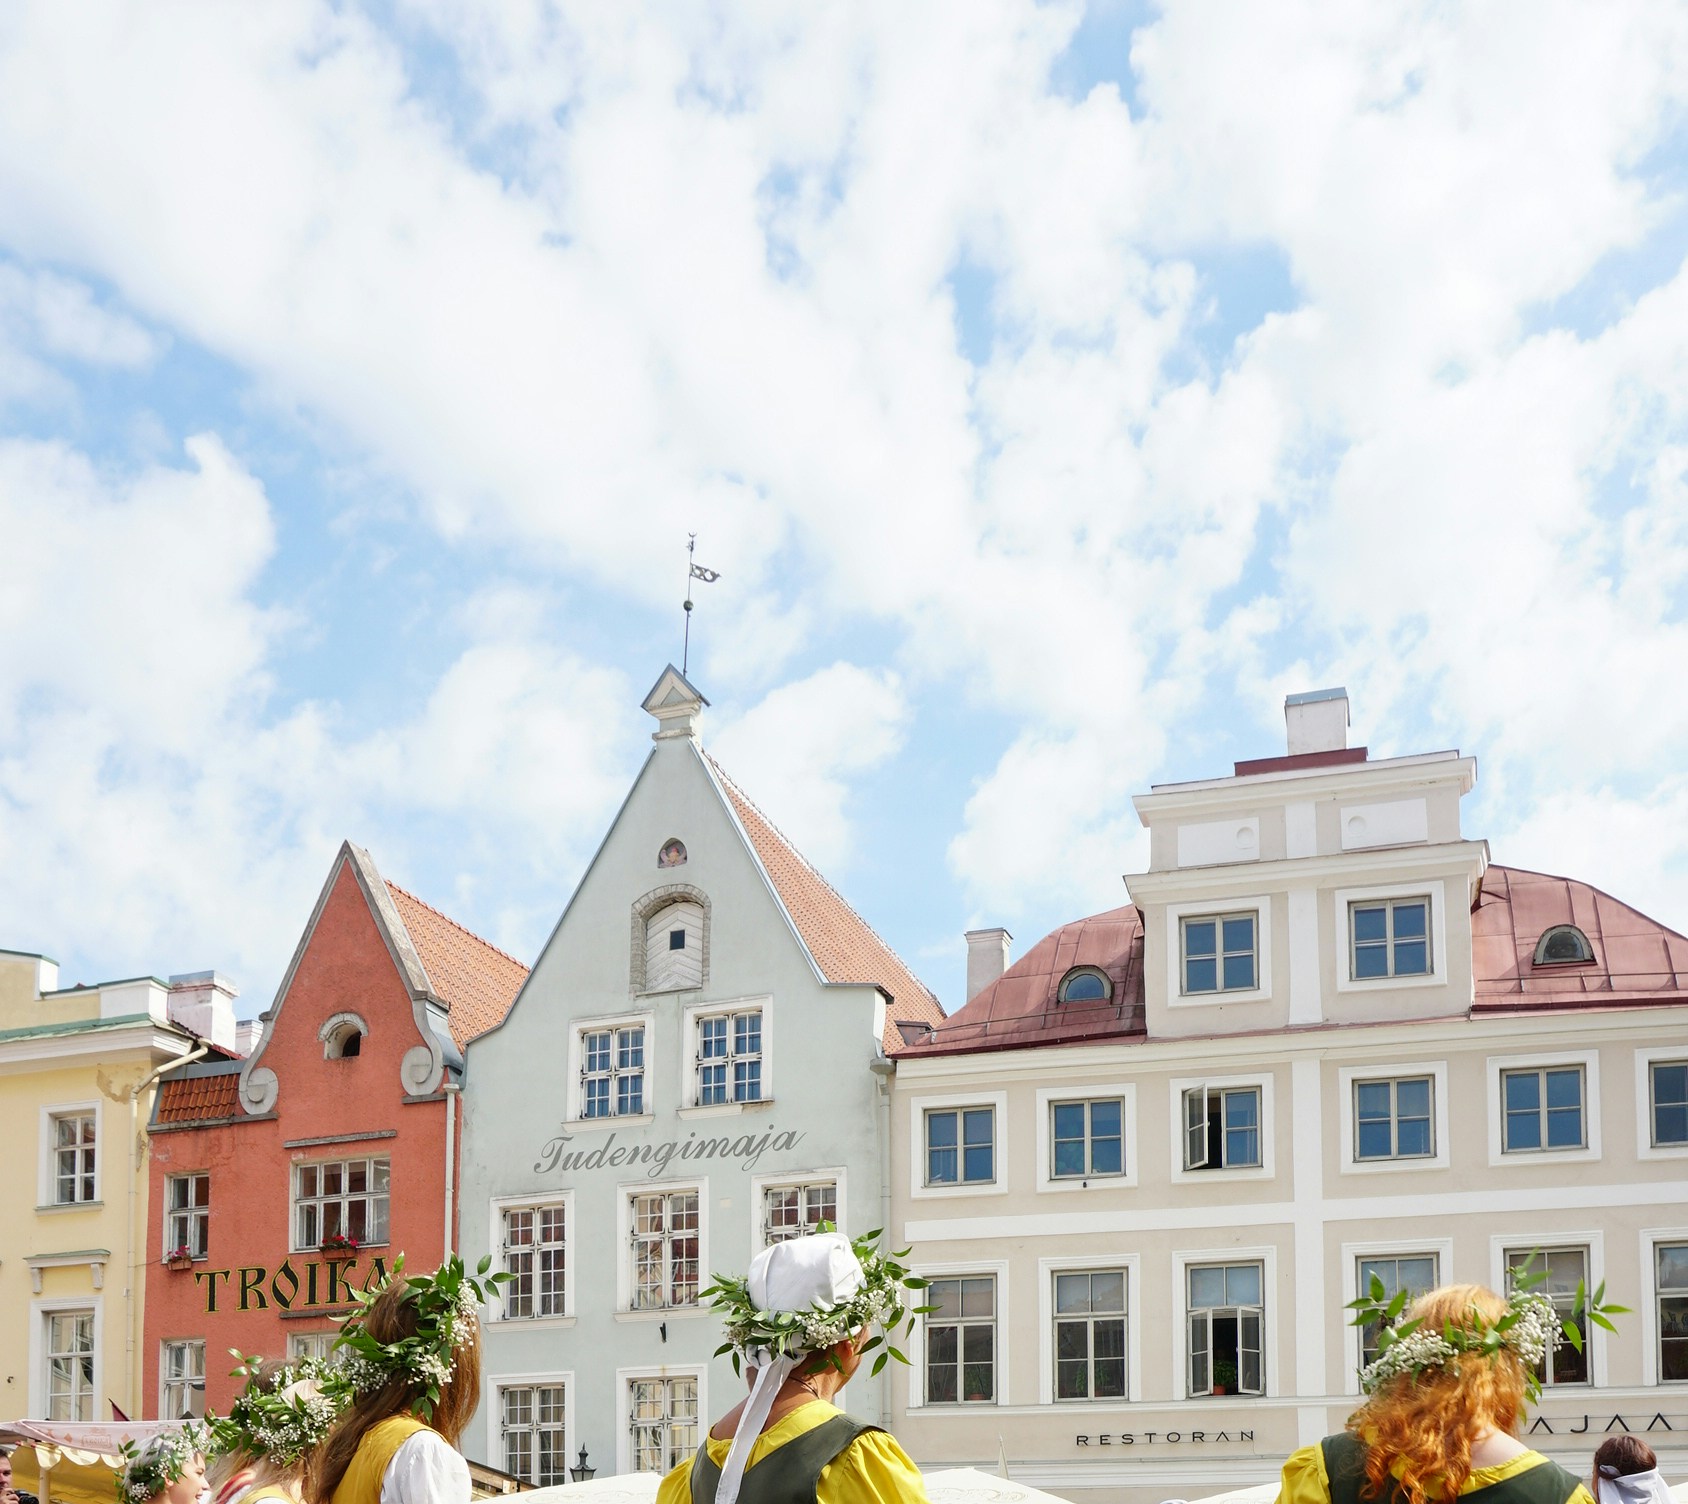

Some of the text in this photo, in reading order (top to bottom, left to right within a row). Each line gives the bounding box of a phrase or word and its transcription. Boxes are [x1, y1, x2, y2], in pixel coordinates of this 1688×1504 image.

[534, 1124, 807, 1178] Tudengimaja
[194, 1256, 389, 1312] TROIKA
[1076, 1430, 1254, 1446] RESTORAN
[1529, 1412, 1673, 1434] AJAA
